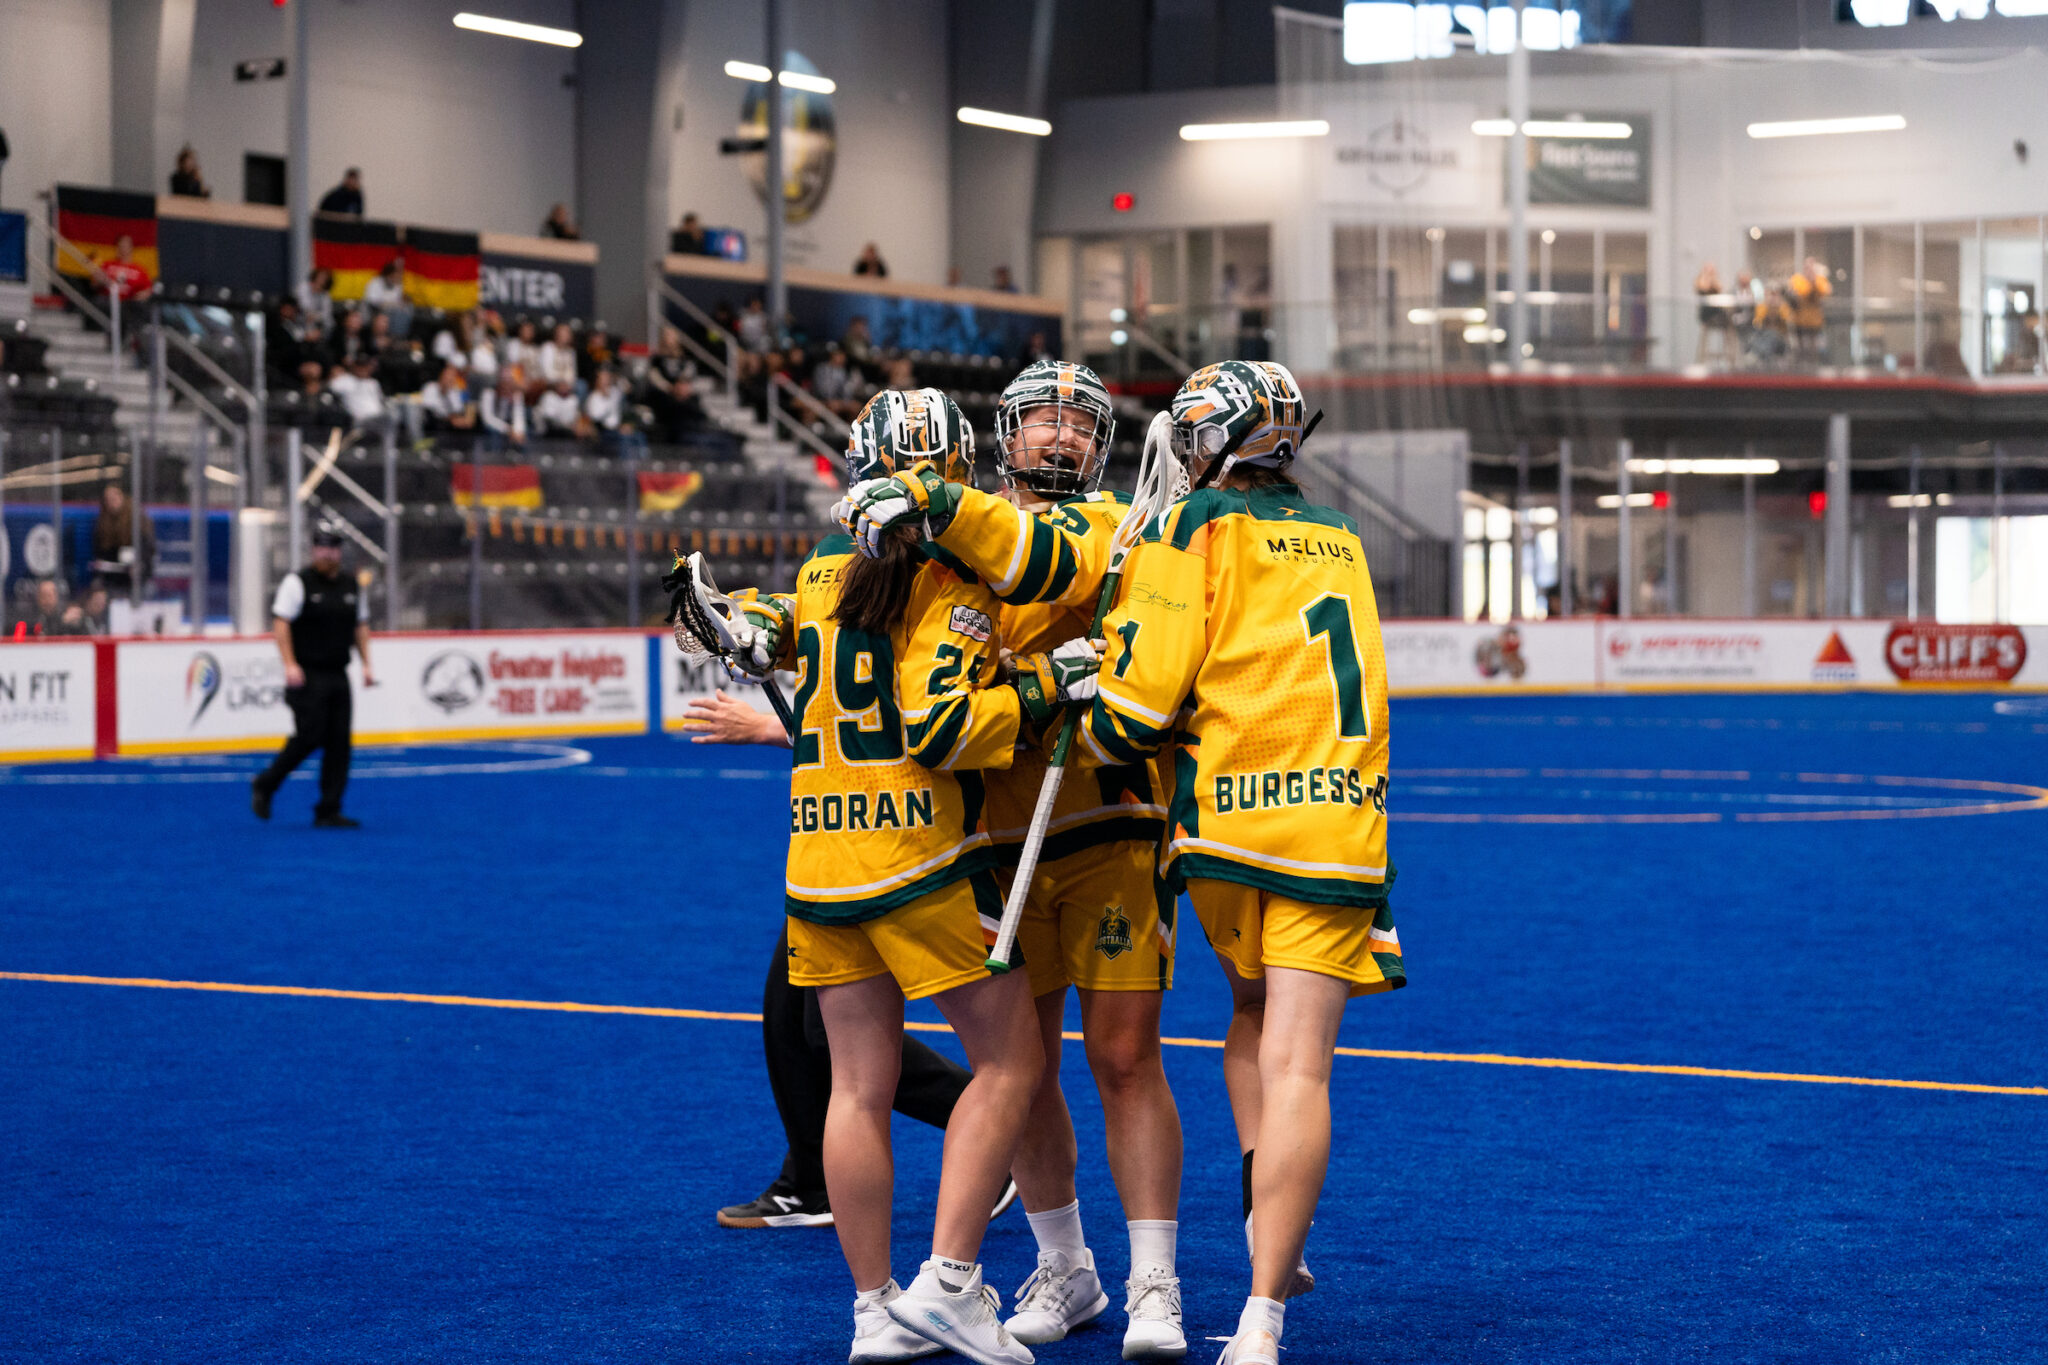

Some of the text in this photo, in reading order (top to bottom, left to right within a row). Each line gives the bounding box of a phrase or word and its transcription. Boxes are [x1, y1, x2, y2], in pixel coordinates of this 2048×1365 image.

[1266, 538, 1354, 562] MELIUS
[1111, 618, 1143, 682] 1
[1300, 591, 1371, 742] 1
[1890, 634, 2020, 669] CLIFF'S
[30, 670, 70, 700] FIT
[794, 621, 908, 767] 29
[791, 787, 935, 836] EGORAN
[941, 1261, 970, 1272] 2XU
